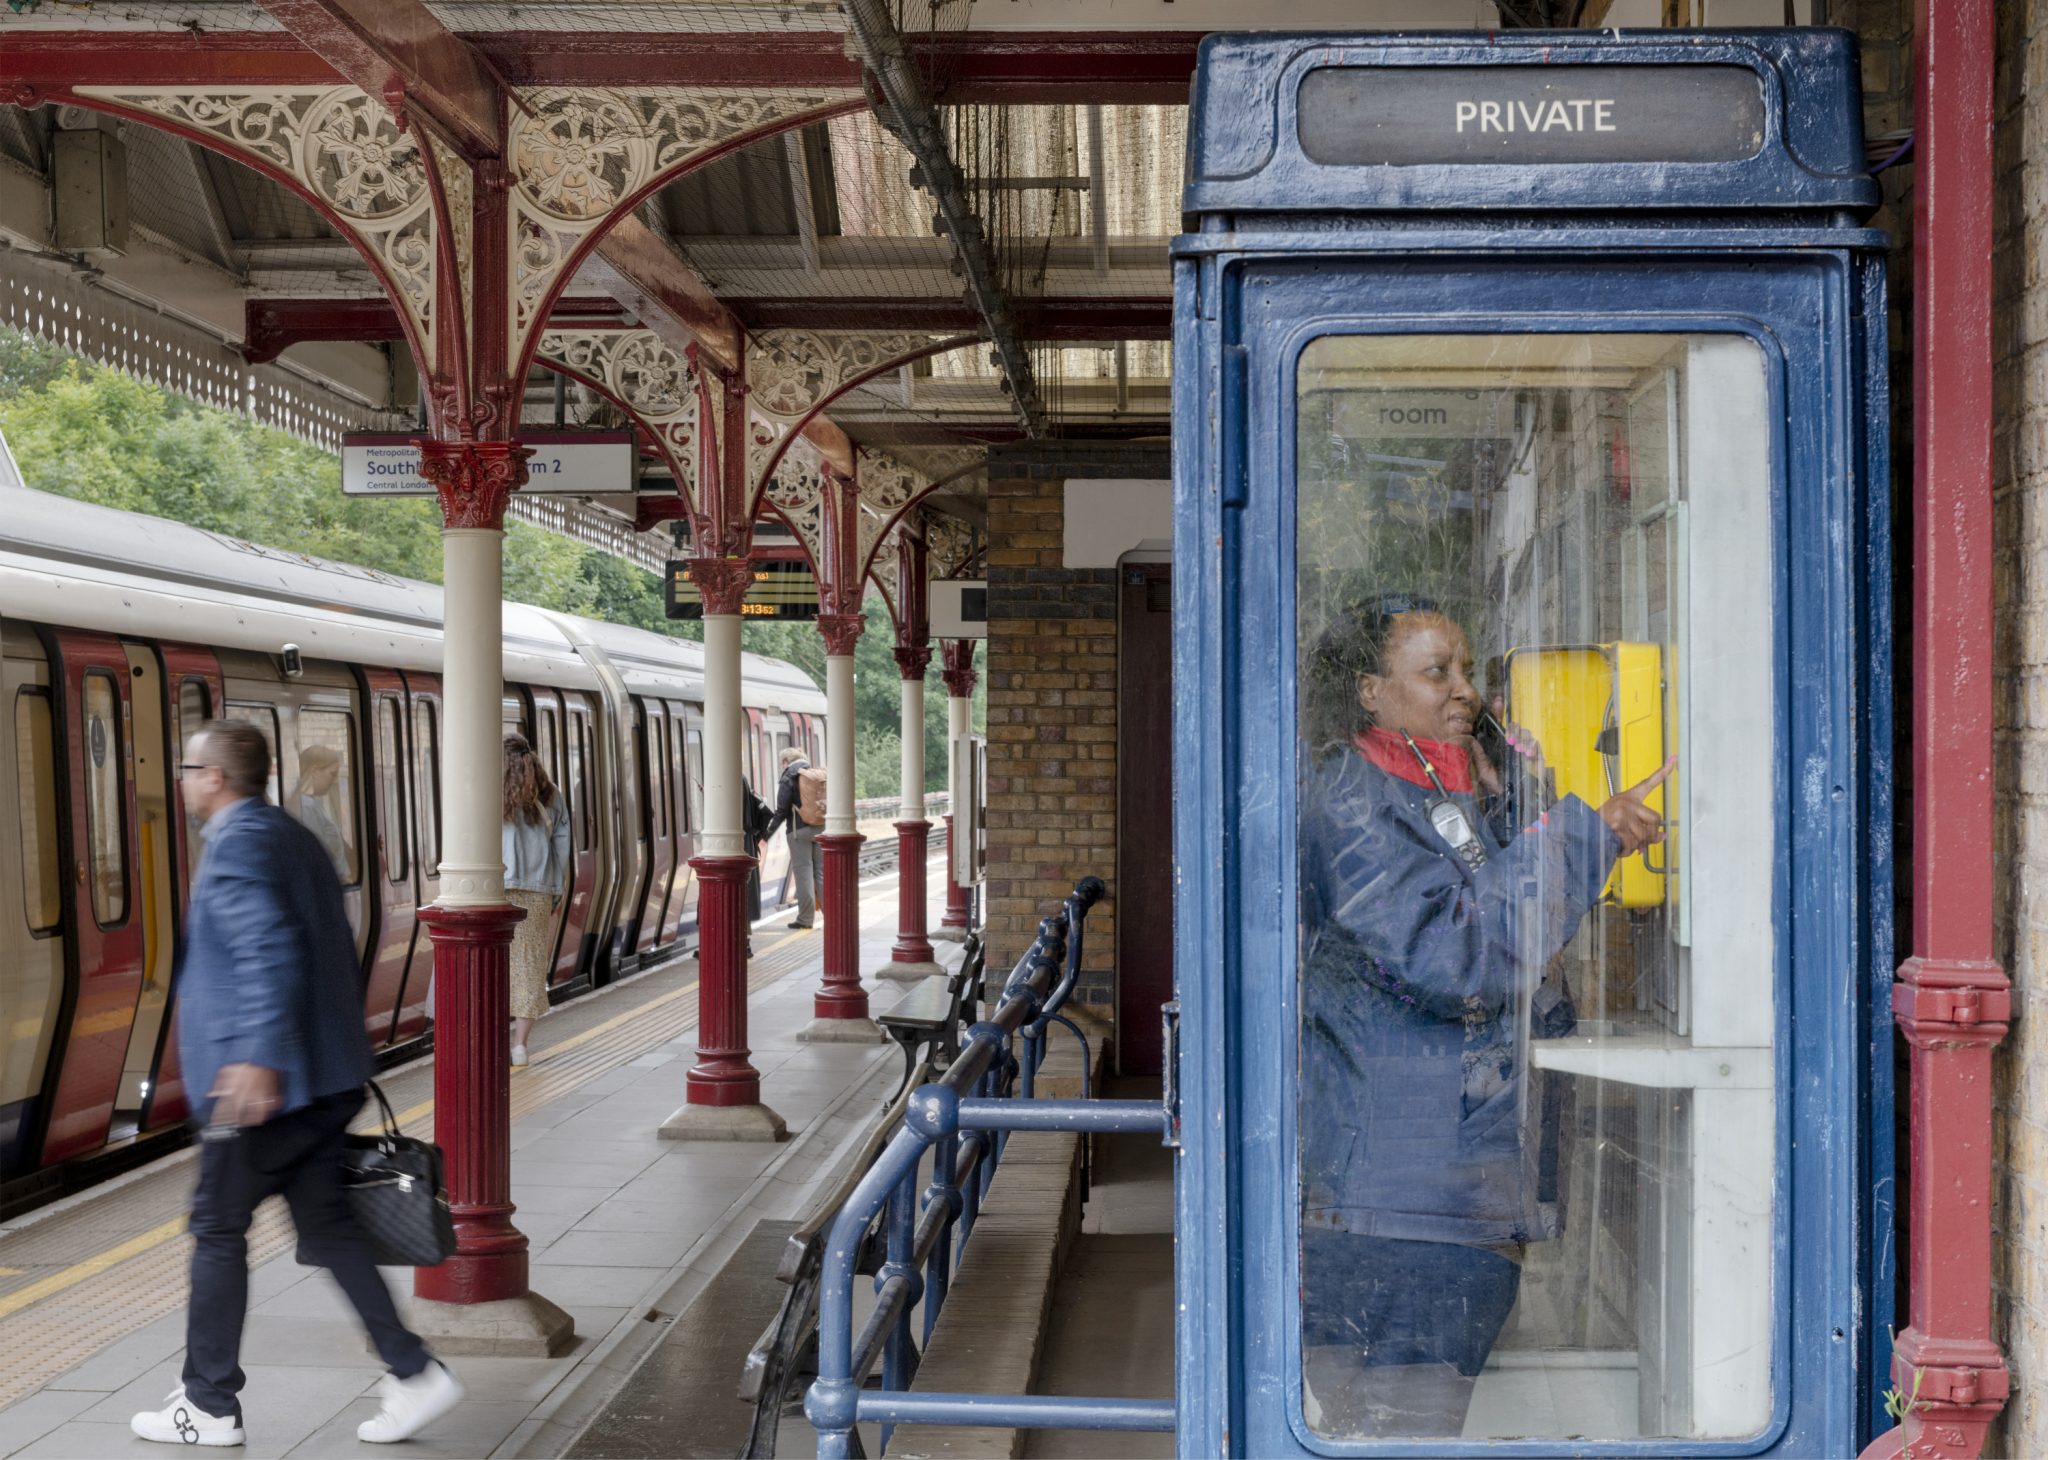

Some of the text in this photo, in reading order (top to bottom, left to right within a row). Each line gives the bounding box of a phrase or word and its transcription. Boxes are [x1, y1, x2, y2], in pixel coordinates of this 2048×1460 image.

[1456, 100, 1616, 132] PRIVATE
[1380, 407, 1447, 424] room
[366, 449, 420, 457] Metropolitan
[367, 461, 420, 475] South
[552, 459, 561, 473] 2
[367, 481, 432, 489] Central London
